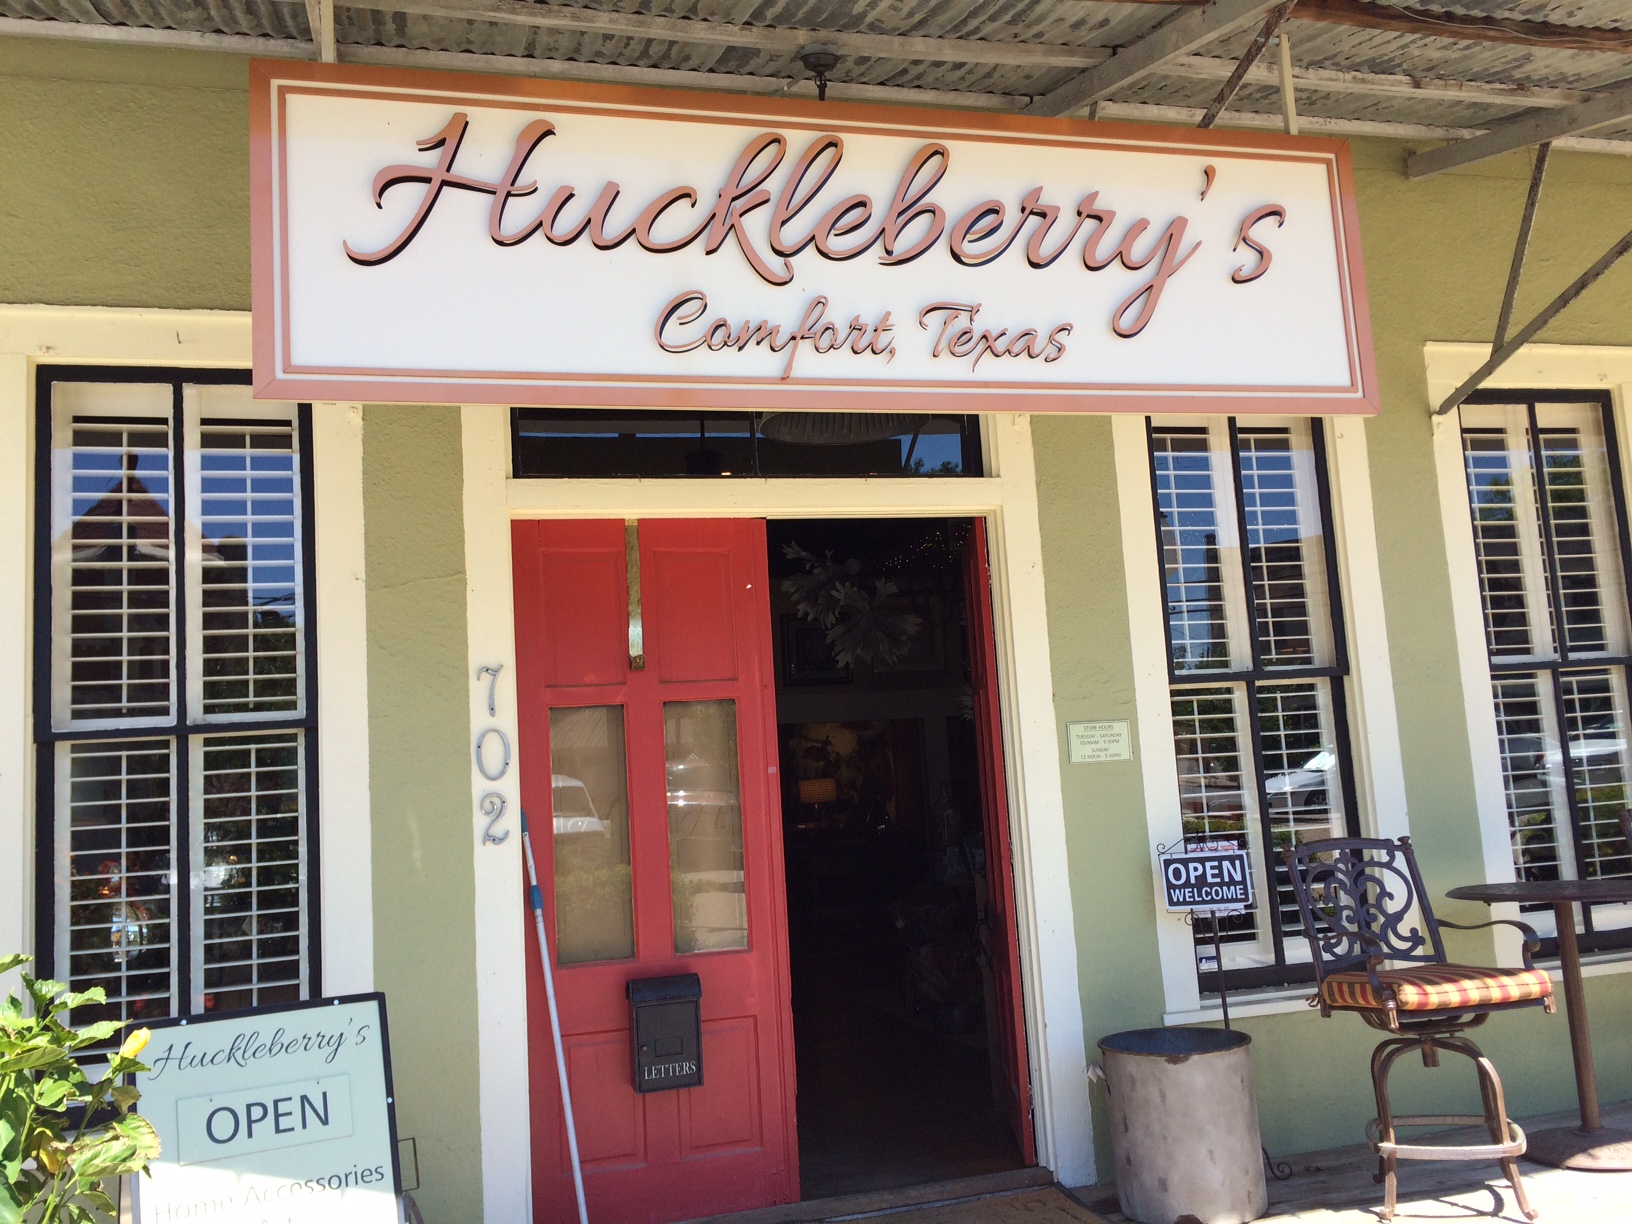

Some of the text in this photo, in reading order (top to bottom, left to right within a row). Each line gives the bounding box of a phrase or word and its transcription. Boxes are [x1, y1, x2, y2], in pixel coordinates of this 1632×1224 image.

[343, 112, 1286, 338] Huckleberry's
[655, 290, 1074, 380] Comfort, Texas
[475, 664, 511, 846] 702
[1167, 860, 1243, 885] OPEN
[1170, 885, 1246, 902] WELCOME
[147, 1017, 370, 1081] Huckleberry's
[644, 1060, 697, 1080] LETTERS
[205, 1090, 330, 1144] OPEN
[154, 1163, 386, 1224] Home Accessories
